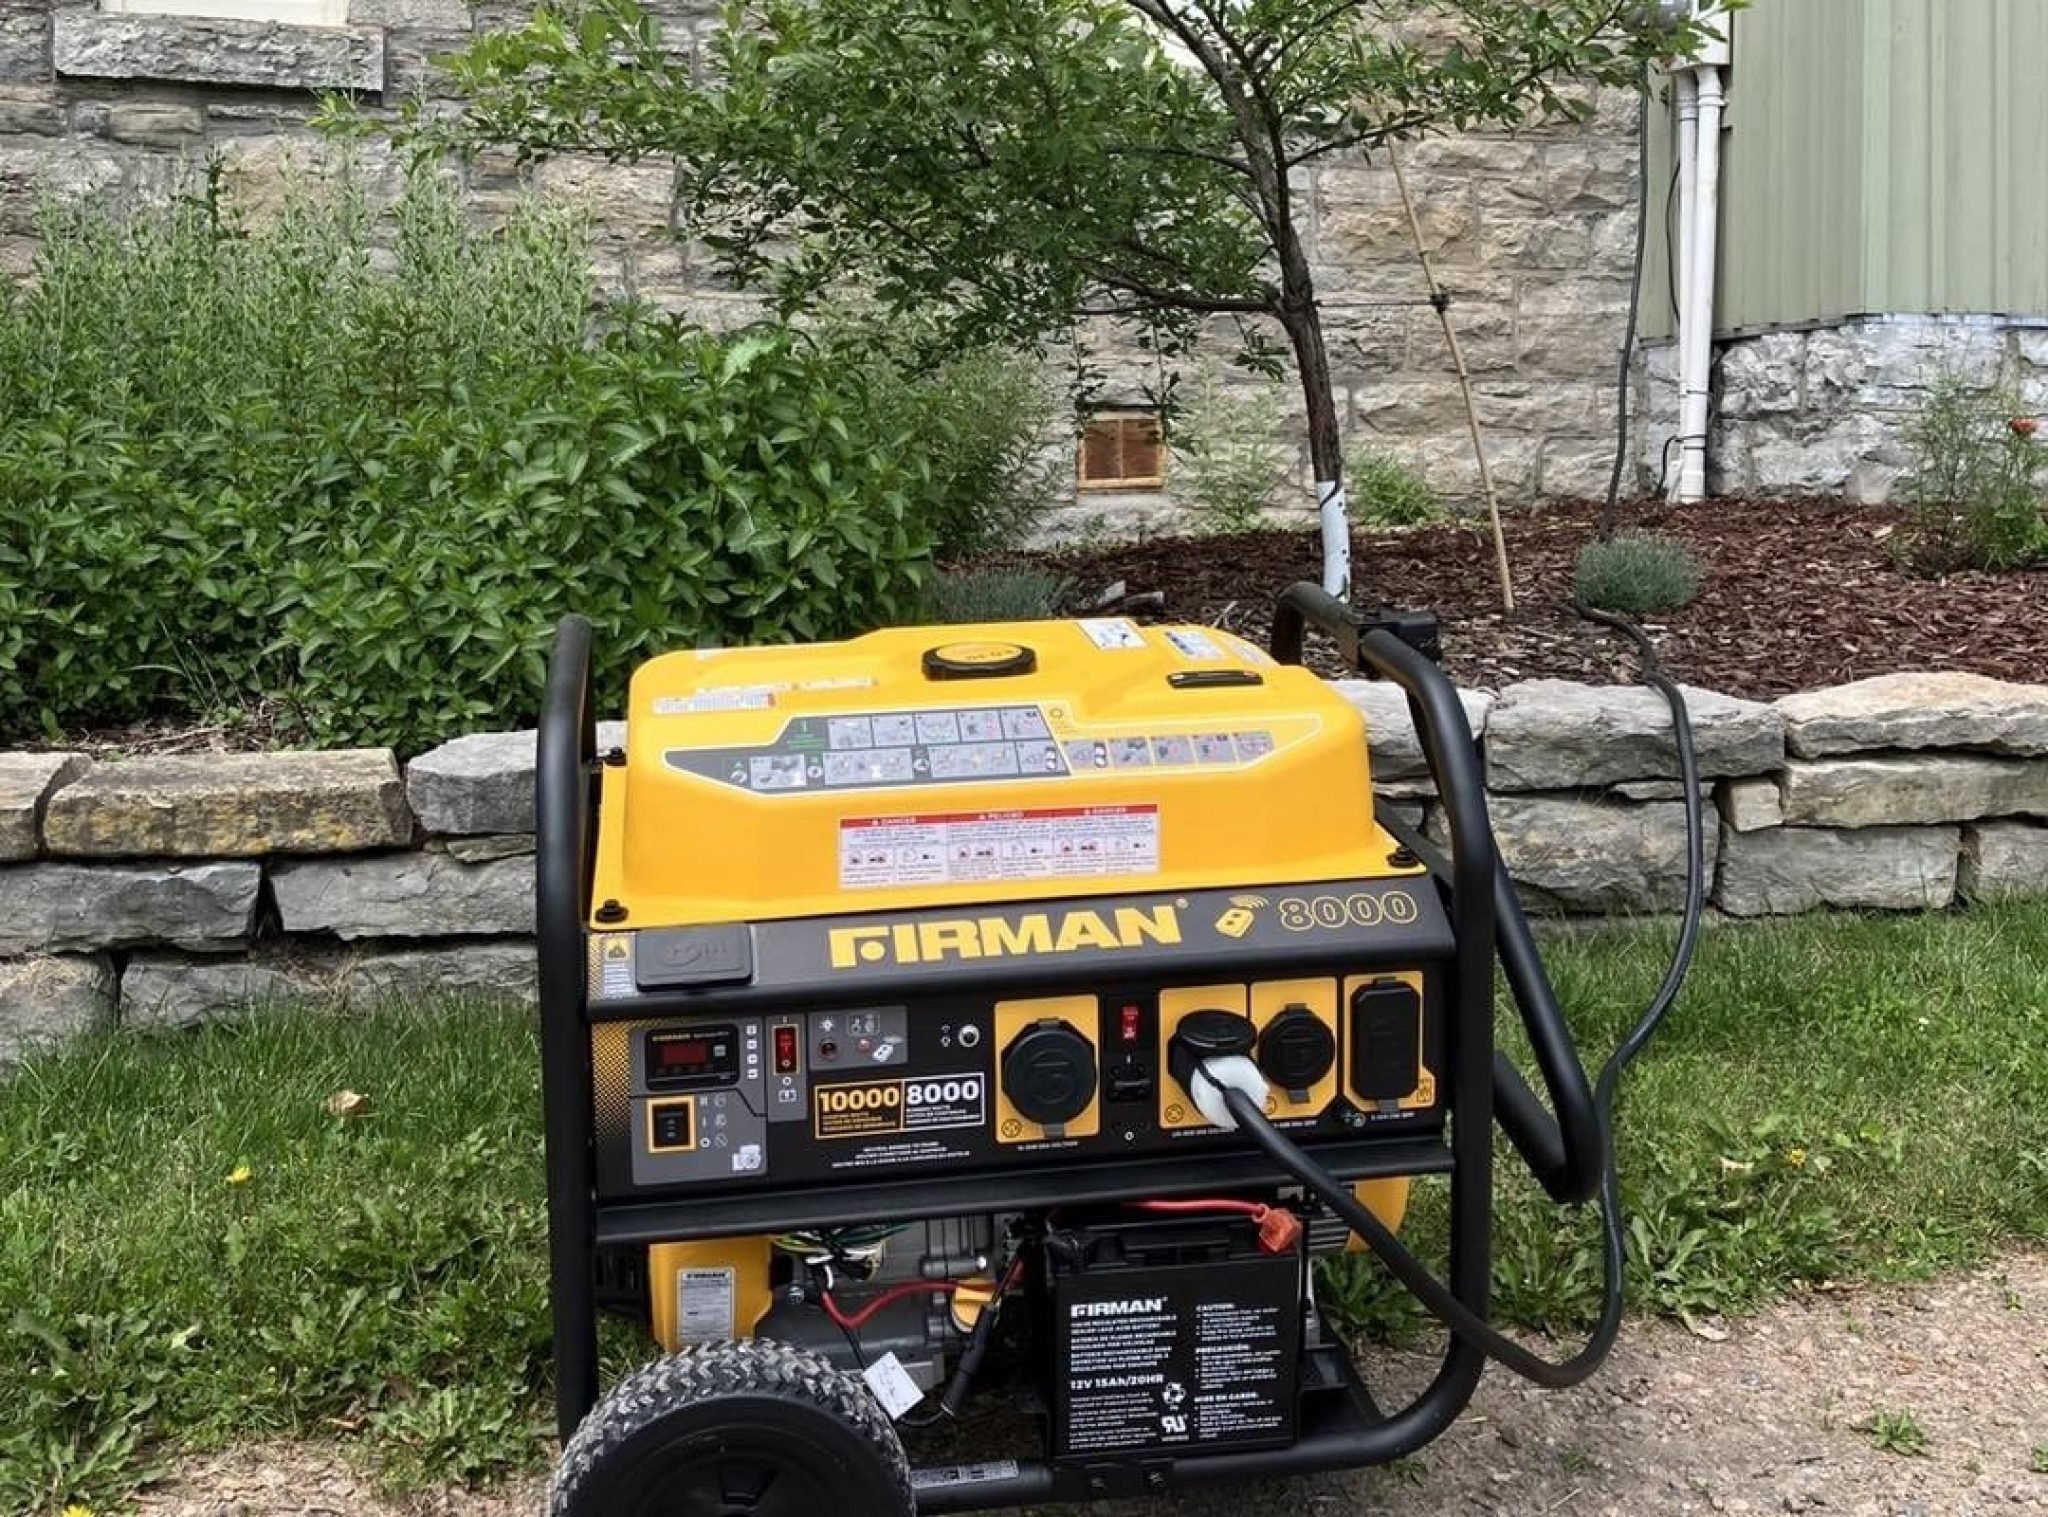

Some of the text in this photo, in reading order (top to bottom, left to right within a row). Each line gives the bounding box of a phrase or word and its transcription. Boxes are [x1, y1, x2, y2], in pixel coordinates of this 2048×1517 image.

[828, 891, 1417, 969] FIRMAN 8000
[819, 1087, 900, 1112] 10000
[907, 1081, 979, 1105] 8000
[1071, 1299, 1162, 1317] FIRMAN
[1071, 1380, 1092, 1390] 12V
